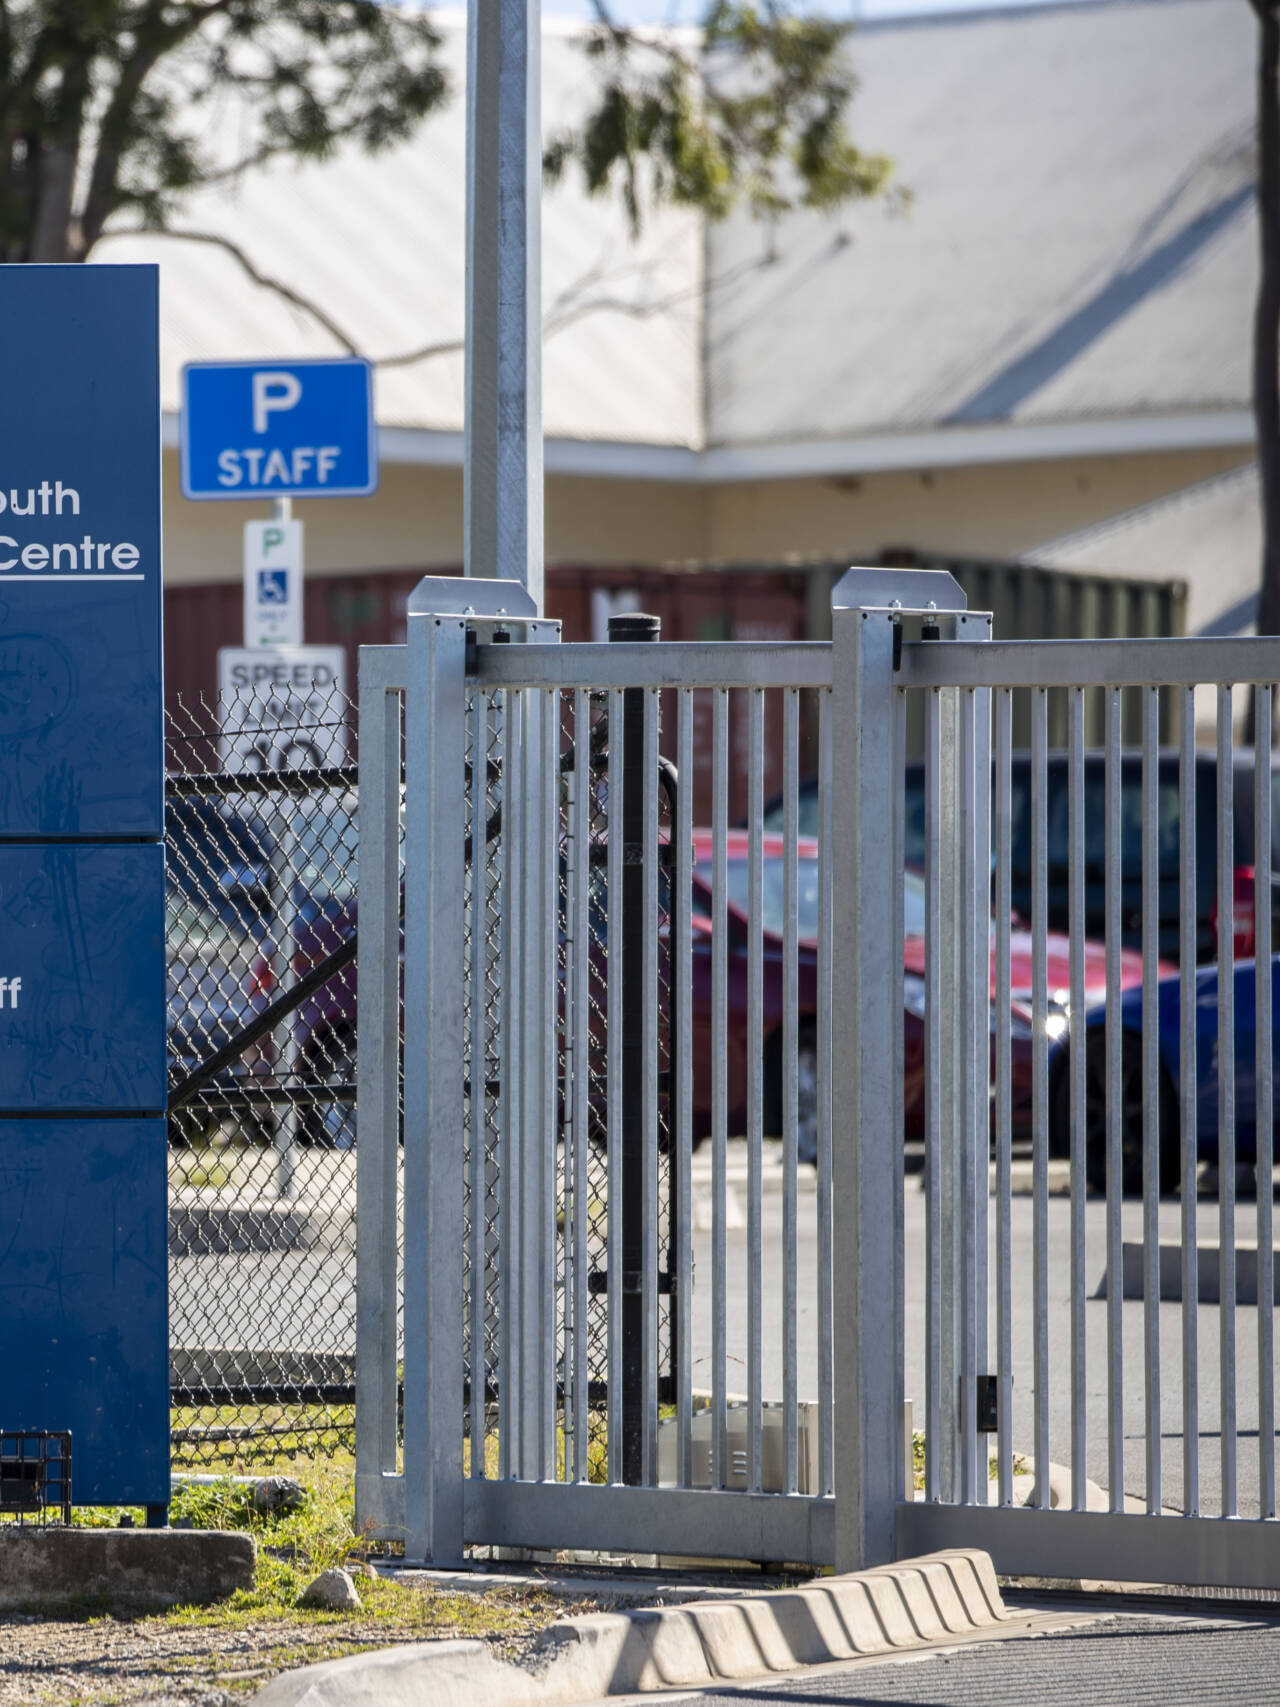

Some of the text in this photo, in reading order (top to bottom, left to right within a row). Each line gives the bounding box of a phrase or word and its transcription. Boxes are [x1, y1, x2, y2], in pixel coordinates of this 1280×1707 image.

[252, 371, 302, 434] P
[217, 446, 341, 487] STAFF
[261, 527, 285, 559] P
[231, 664, 333, 688] SPEED
